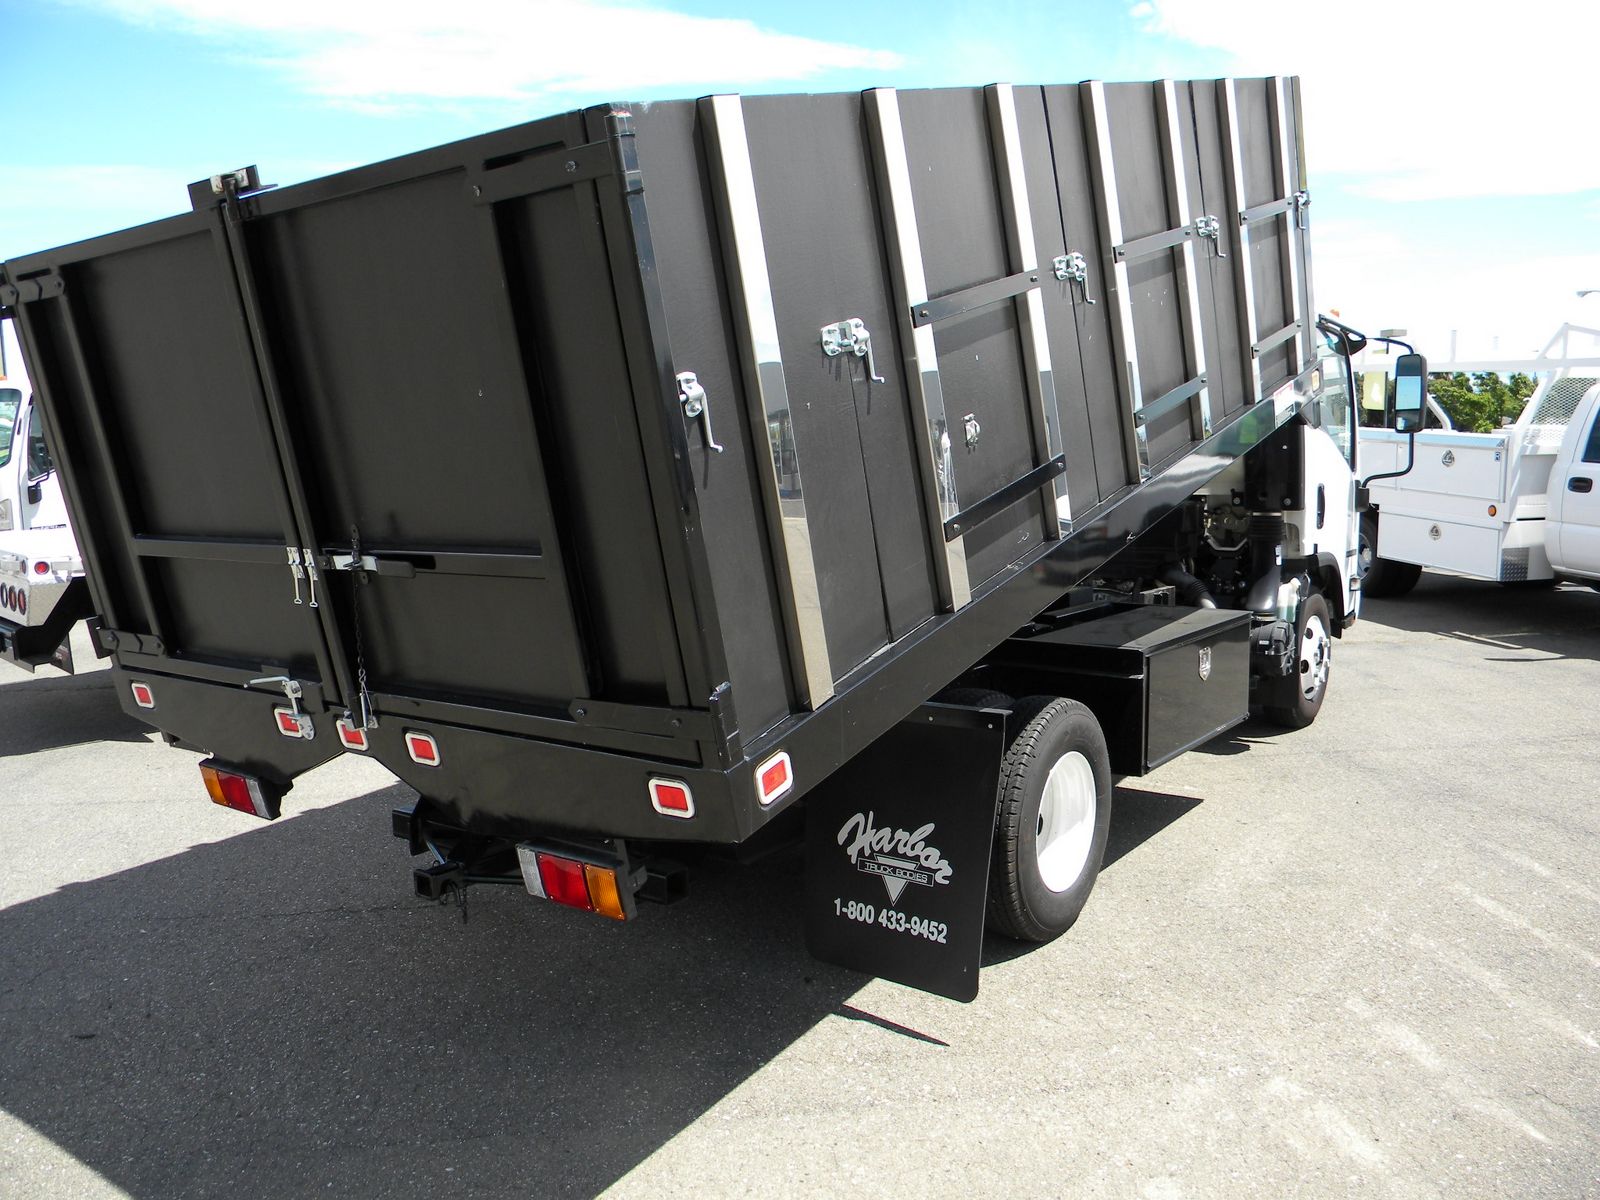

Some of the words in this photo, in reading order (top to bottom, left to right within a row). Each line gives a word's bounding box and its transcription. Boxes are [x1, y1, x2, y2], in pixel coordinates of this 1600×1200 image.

[864, 862, 895, 876] TRUCK
[896, 869, 928, 884] BODIES
[834, 898, 875, 924] 1-800
[878, 909, 948, 944] 433-9452
